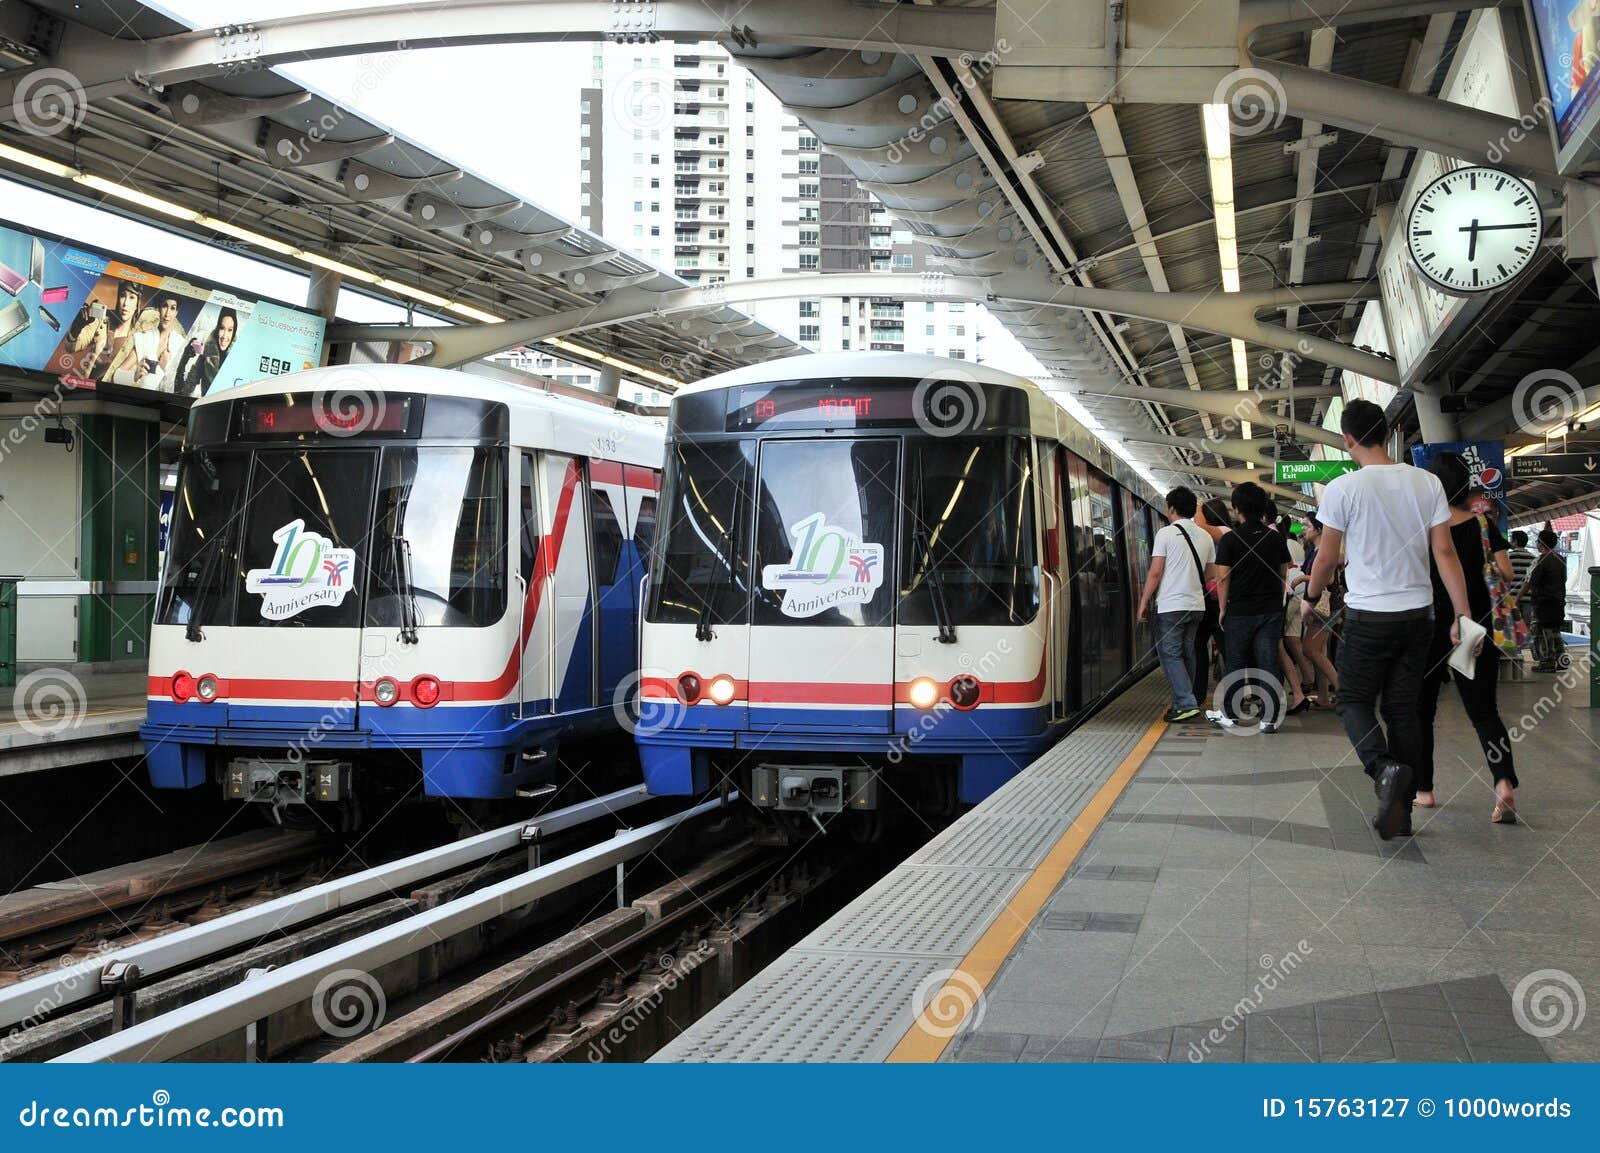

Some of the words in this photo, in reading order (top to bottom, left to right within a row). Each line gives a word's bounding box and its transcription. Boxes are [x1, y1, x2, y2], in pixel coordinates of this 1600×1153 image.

[1282, 464, 1316, 473] ทางออก
[265, 588, 340, 615] Anniversary
[786, 584, 870, 613] Anniversary
